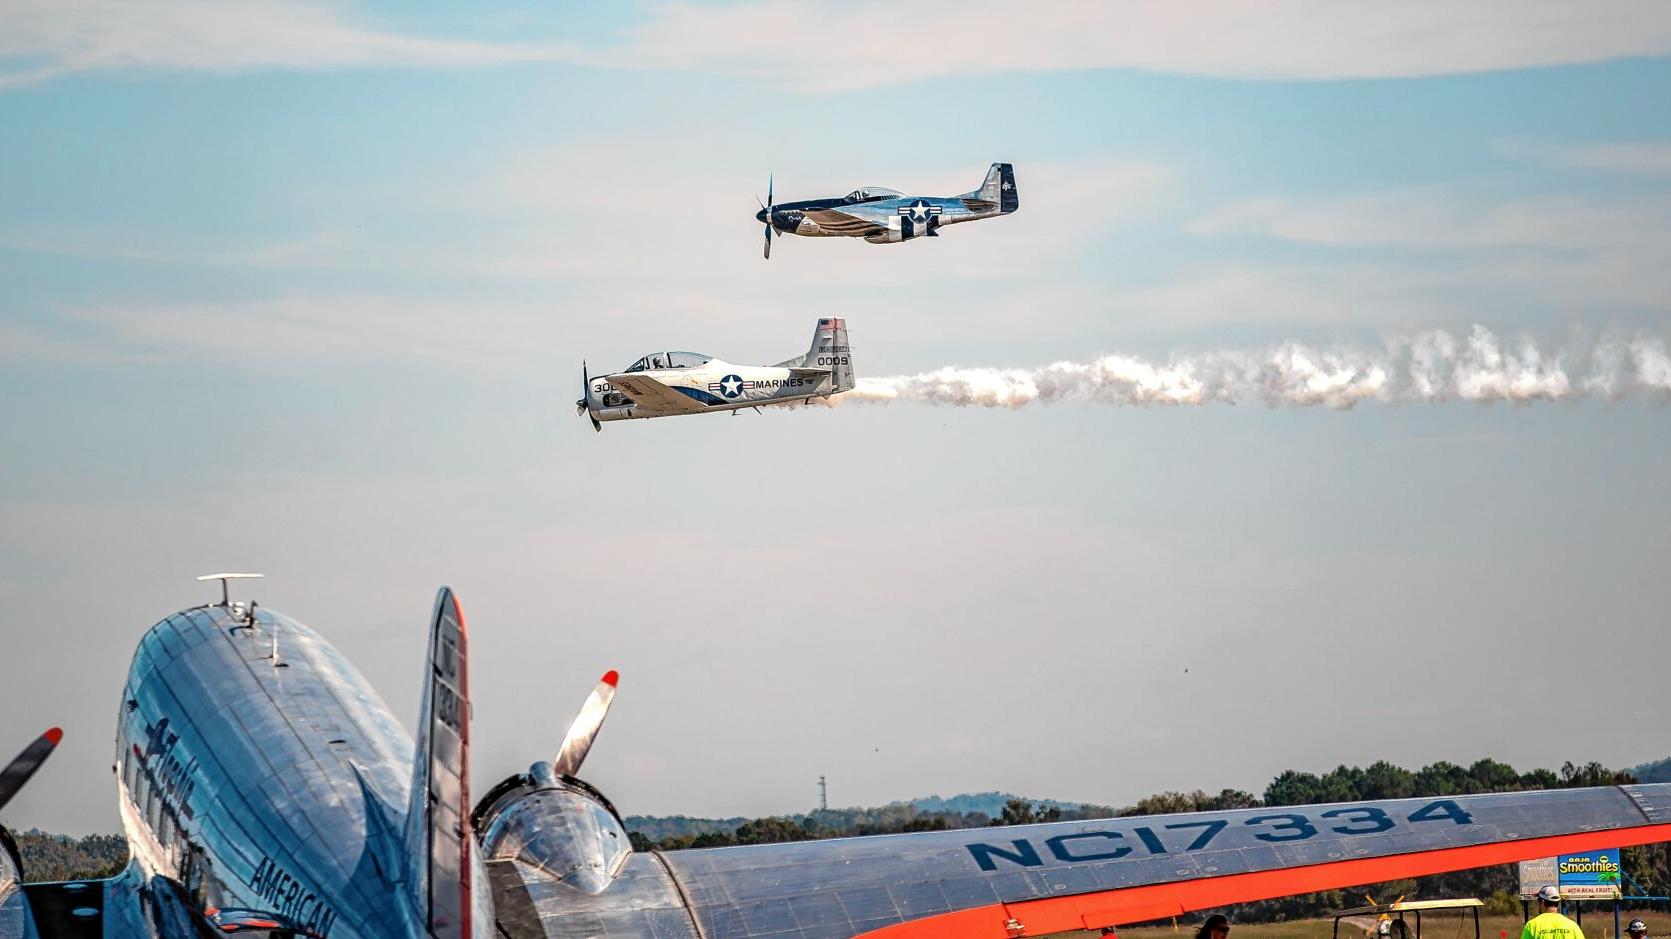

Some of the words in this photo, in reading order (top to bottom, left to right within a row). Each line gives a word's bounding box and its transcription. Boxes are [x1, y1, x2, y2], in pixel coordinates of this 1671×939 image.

[818, 357, 849, 365] 0009
[756, 379, 804, 388] MARINES
[966, 799, 1475, 871] NC17334
[1559, 858, 1619, 873] Smoothies
[249, 856, 337, 939] AMERICAN
